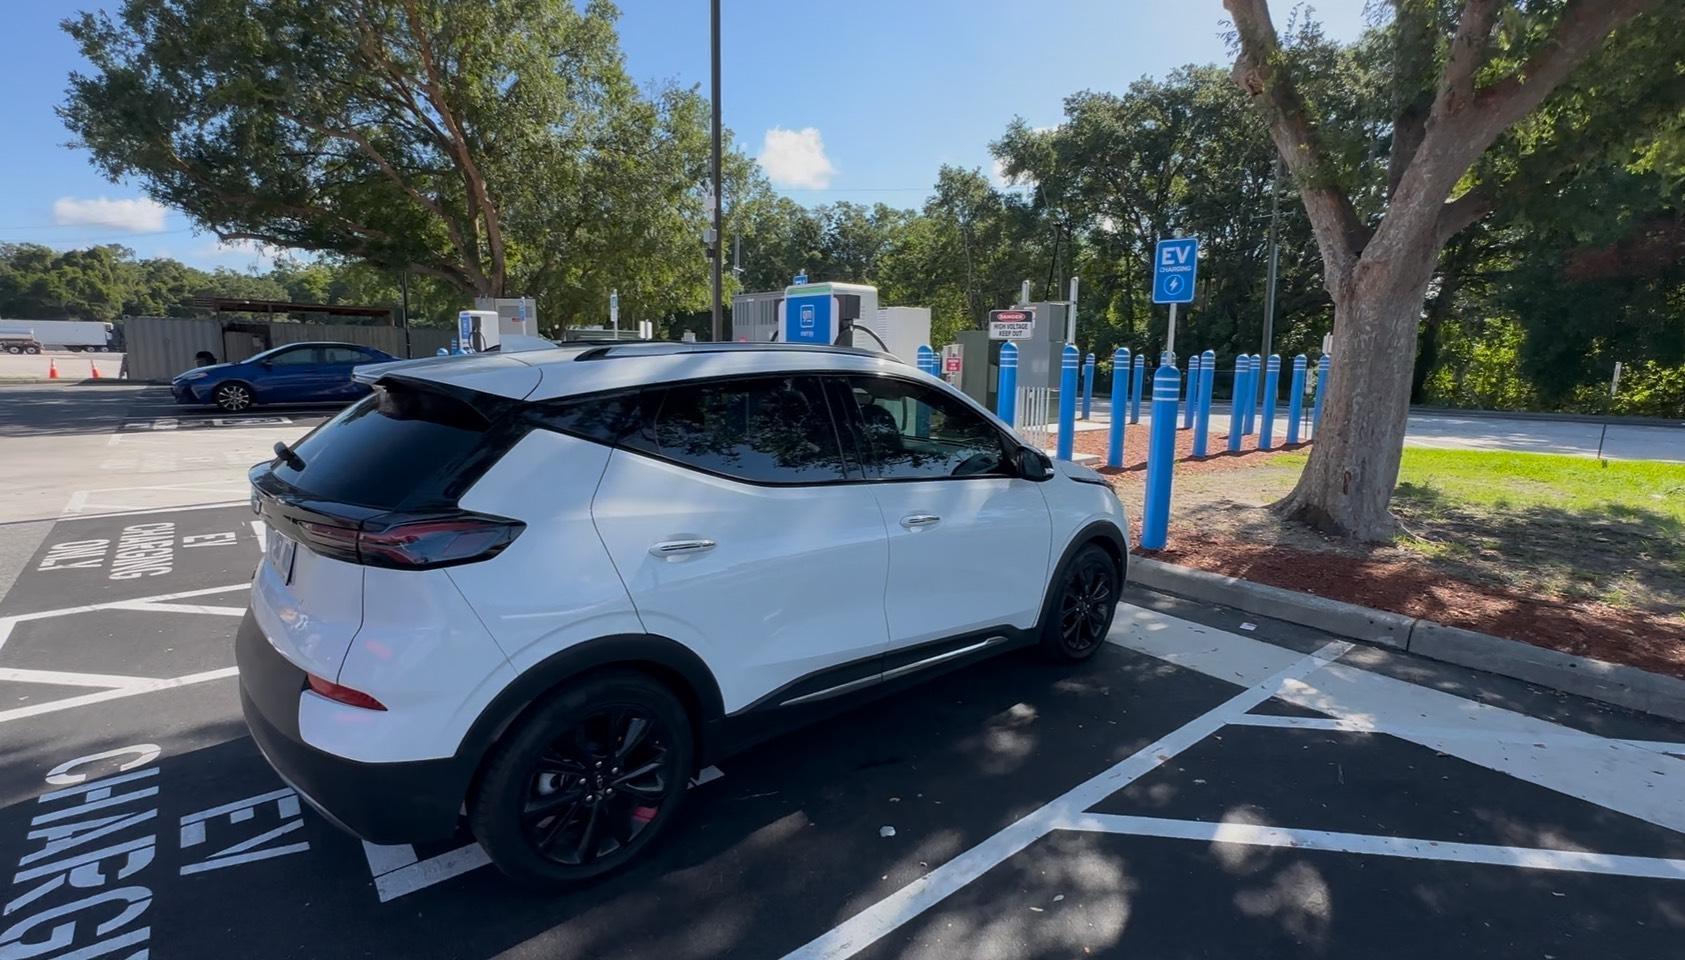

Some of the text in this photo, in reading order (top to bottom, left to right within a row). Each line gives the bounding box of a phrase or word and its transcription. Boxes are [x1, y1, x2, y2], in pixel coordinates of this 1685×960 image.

[1161, 246, 1191, 265] EV
[1159, 265, 1192, 273] CHARGING
[109, 522, 175, 580] CHARGING
[183, 532, 238, 549] EV
[37, 539, 110, 571] ONLY
[180, 787, 310, 876] EV
